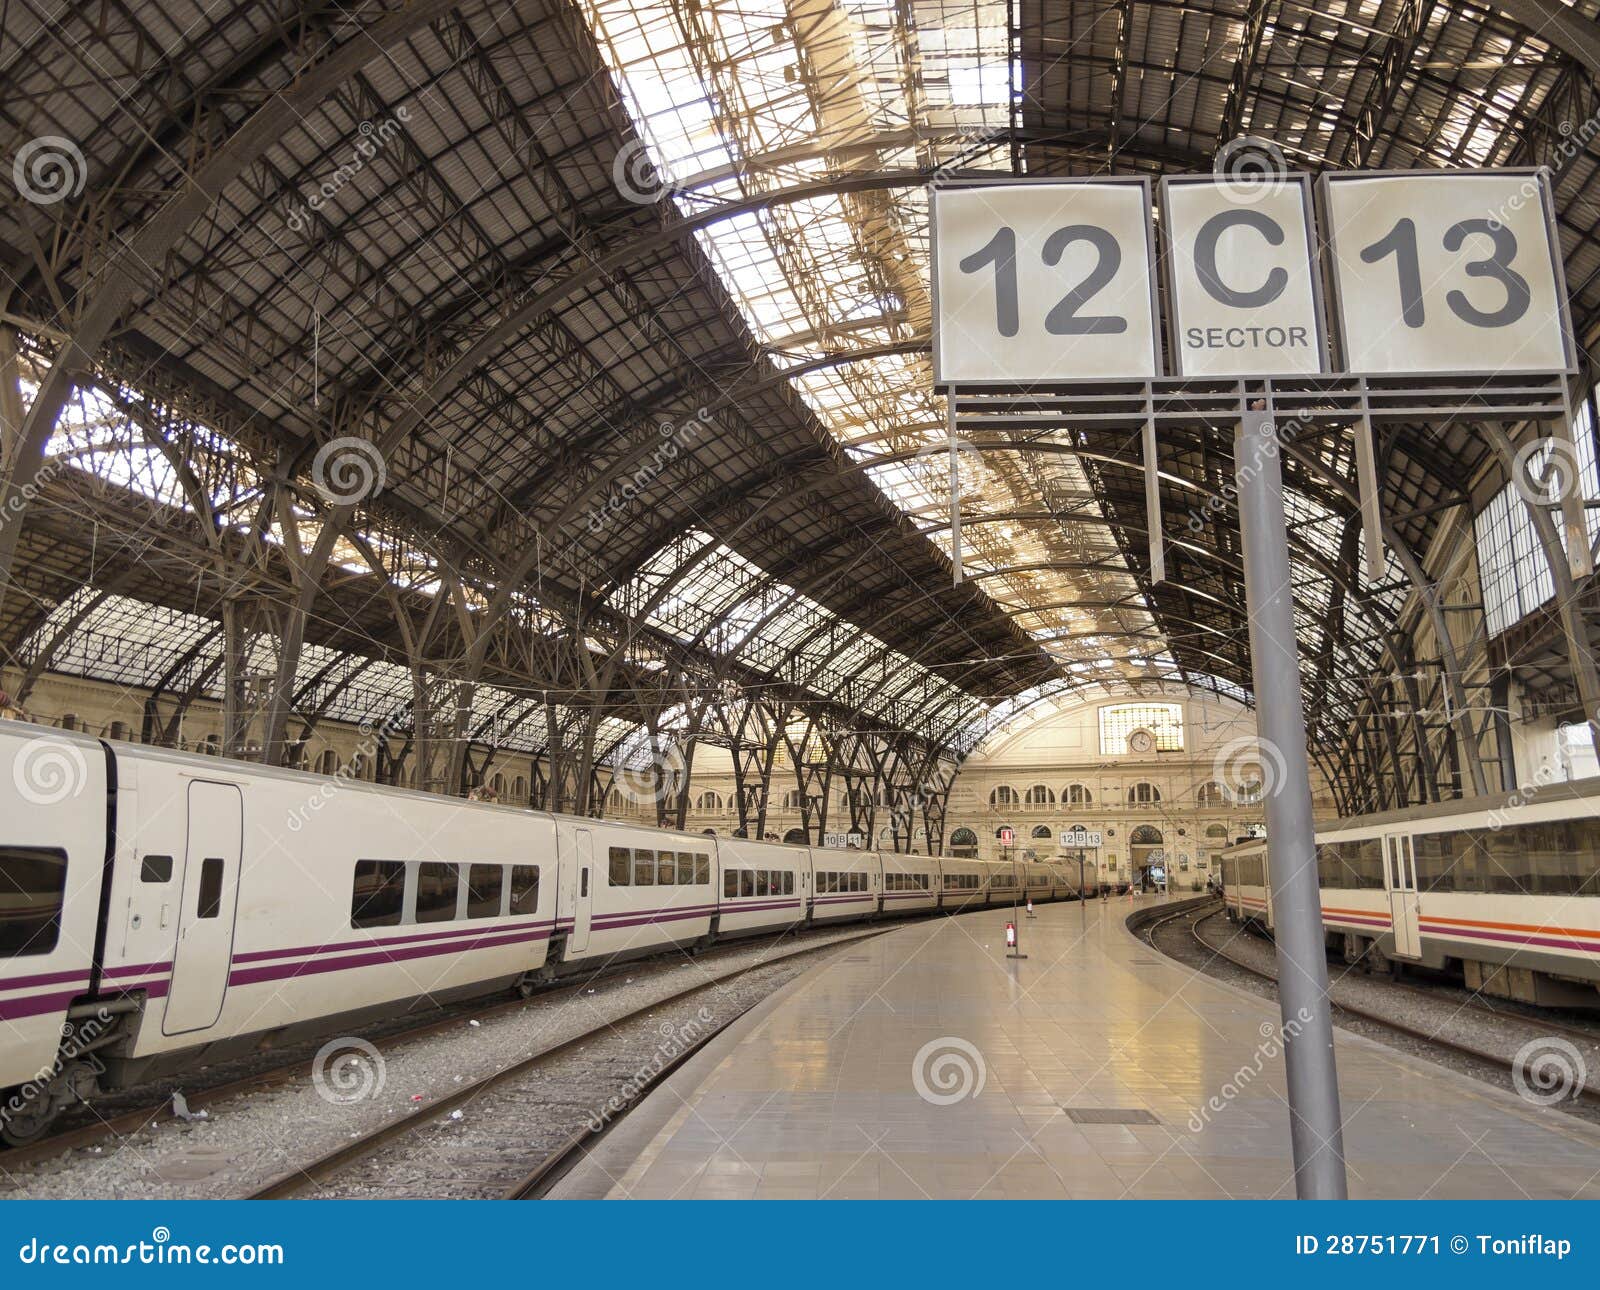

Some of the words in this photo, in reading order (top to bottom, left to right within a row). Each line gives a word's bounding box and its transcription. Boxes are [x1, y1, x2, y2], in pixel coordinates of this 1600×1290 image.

[959, 225, 1128, 338] 12
[1193, 208, 1289, 309] C
[1359, 217, 1531, 328] 13
[1186, 326, 1308, 349] SECTOR
[1062, 835, 1074, 844] 12
[1088, 834, 1100, 843] 13
